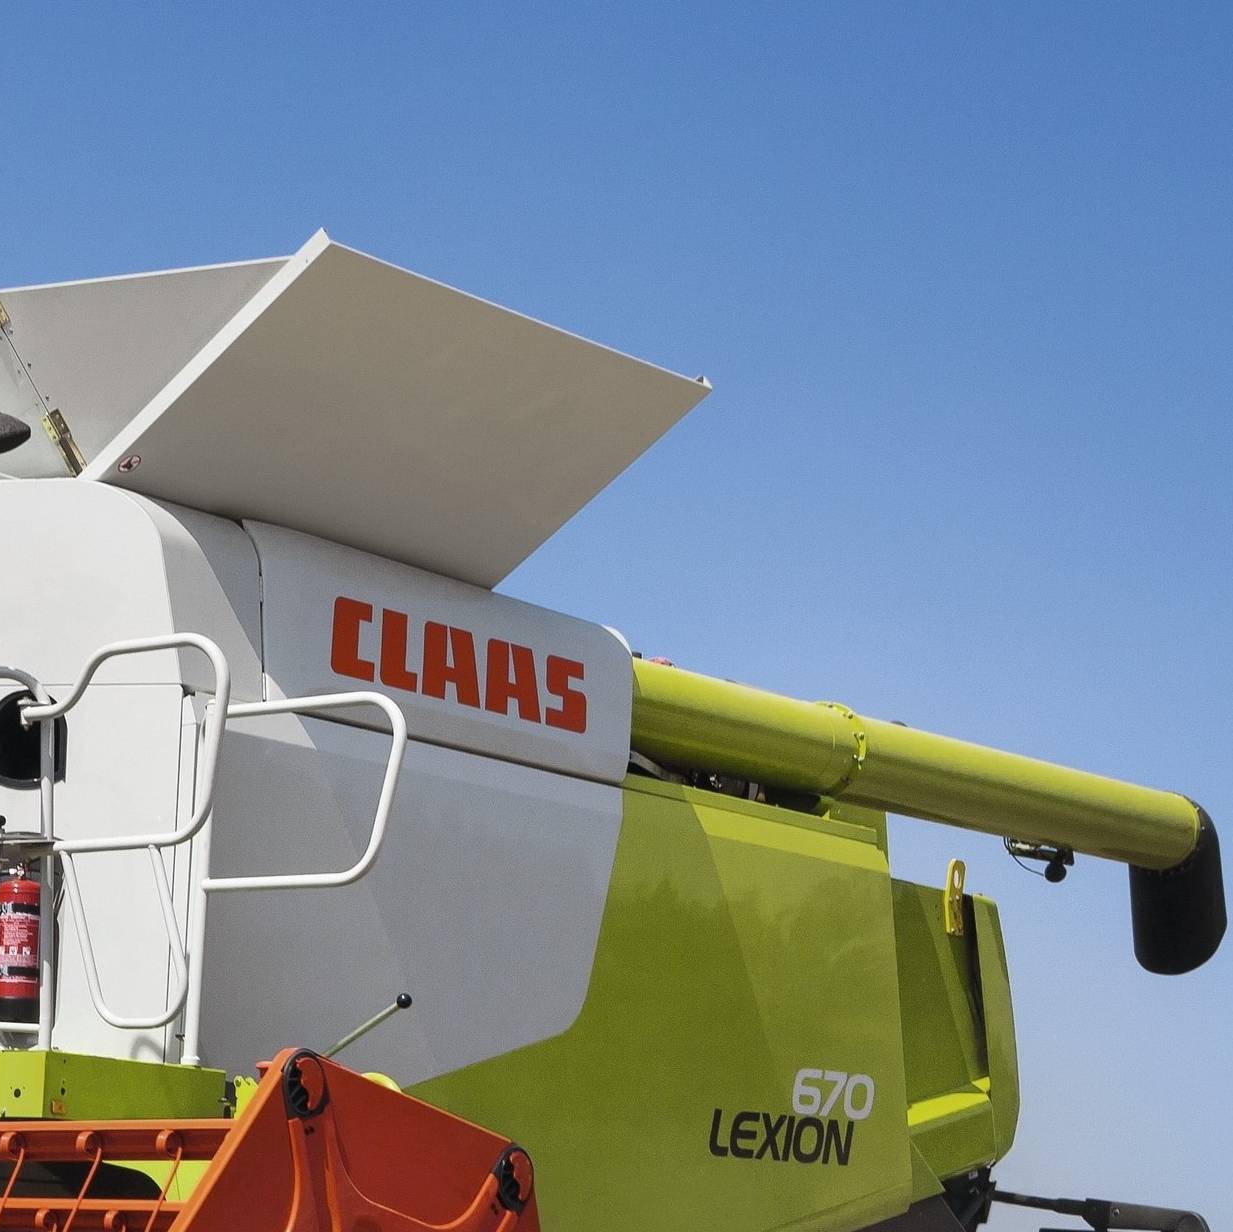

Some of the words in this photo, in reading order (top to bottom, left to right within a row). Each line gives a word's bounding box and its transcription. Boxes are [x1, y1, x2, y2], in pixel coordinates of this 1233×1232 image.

[330, 596, 587, 734] CLAAS
[792, 1068, 875, 1120] 670
[709, 1108, 854, 1166] LEXION
